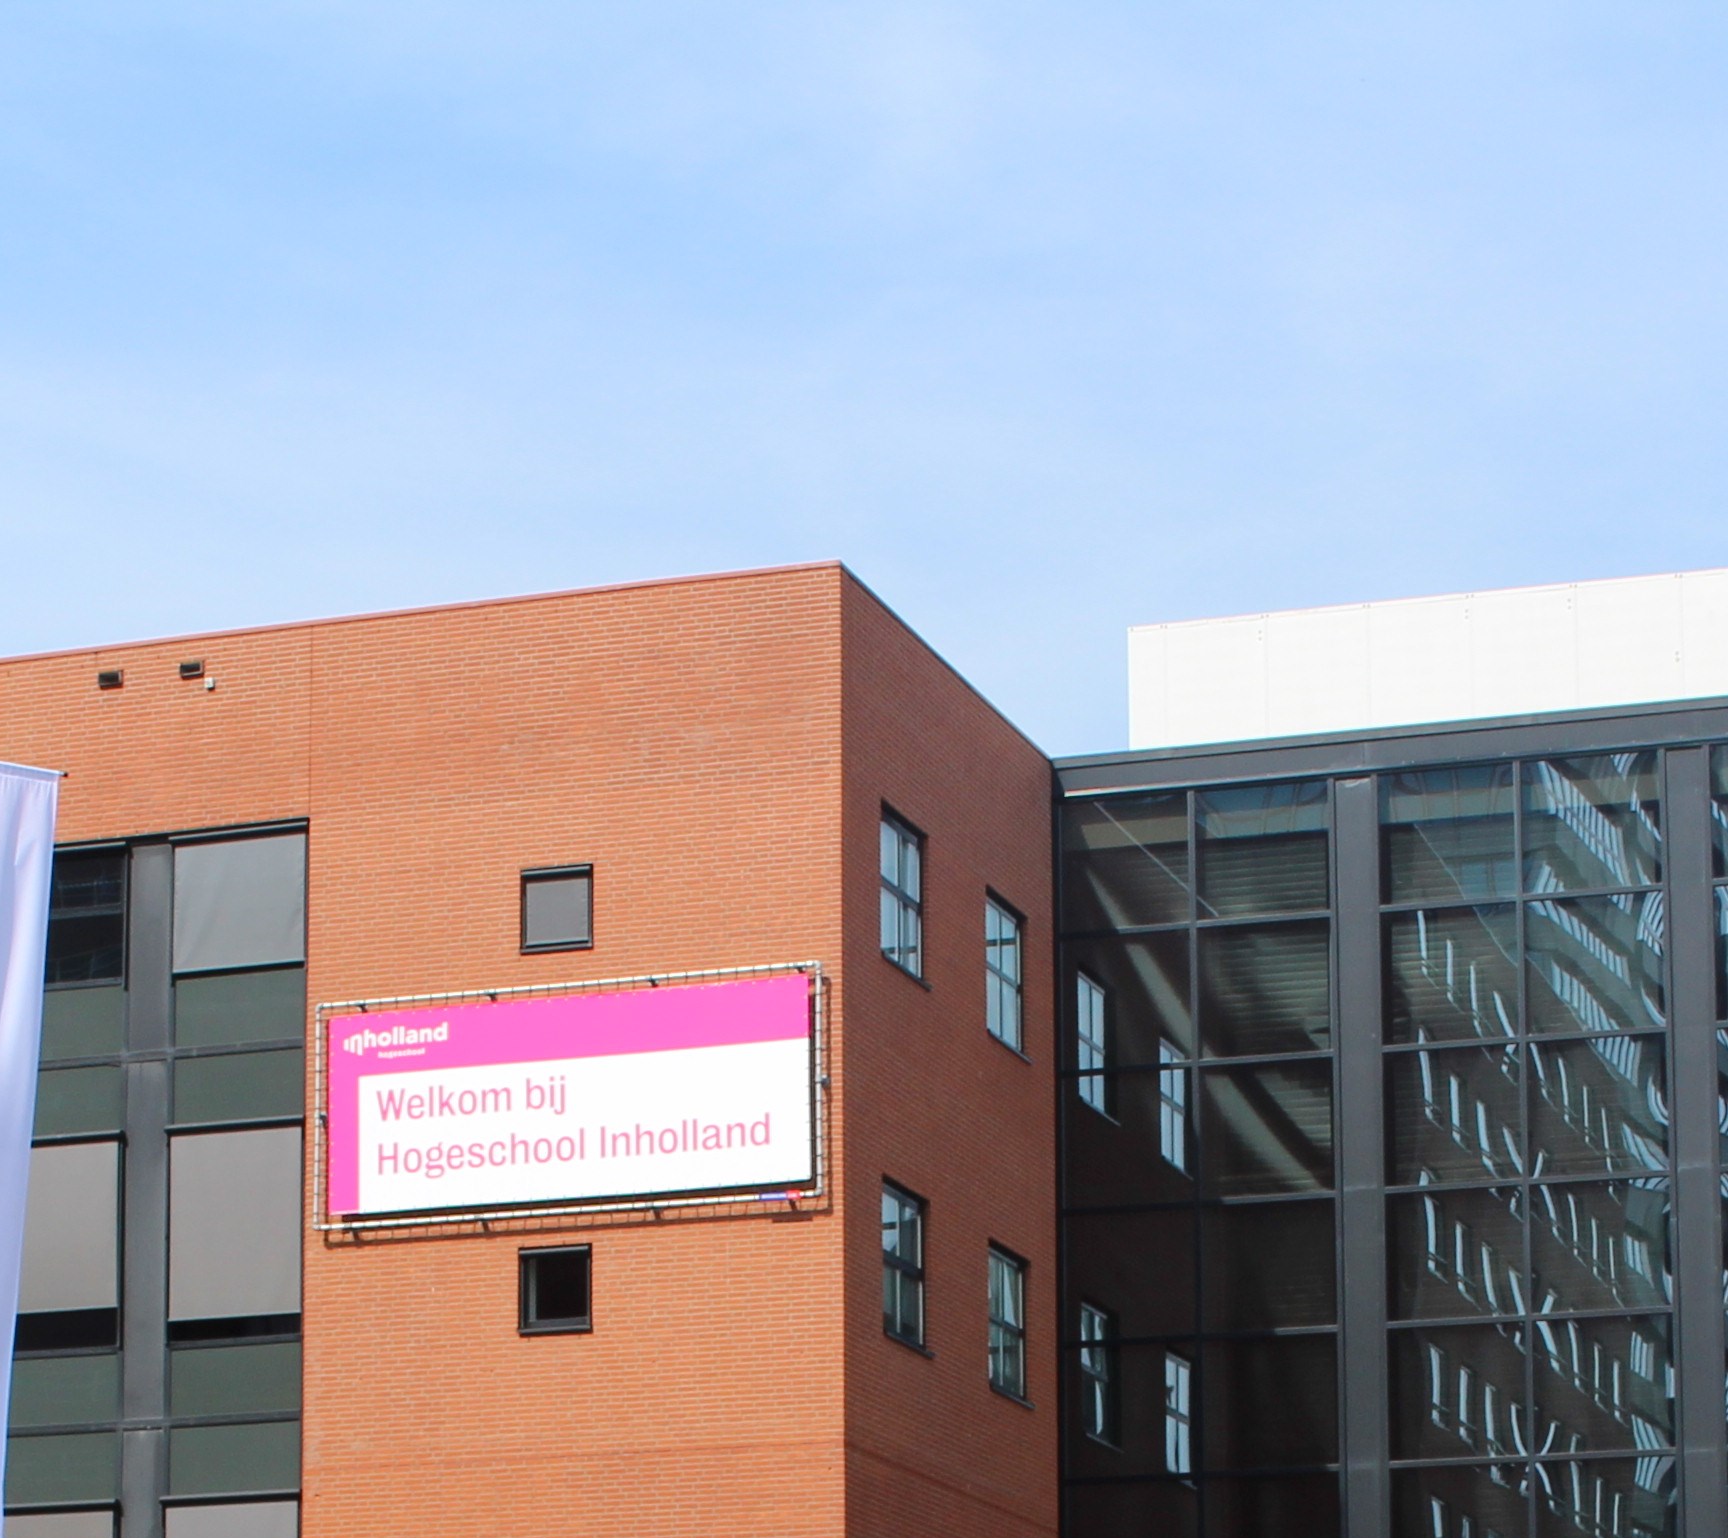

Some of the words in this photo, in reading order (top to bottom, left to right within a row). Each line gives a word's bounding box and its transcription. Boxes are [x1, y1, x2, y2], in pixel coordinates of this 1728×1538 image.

[343, 1021, 449, 1056] inholland
[377, 1047, 426, 1059] hogeschool
[377, 1084, 512, 1121] Welkom
[525, 1075, 566, 1116] bij
[378, 1127, 585, 1179] Hogeschool
[600, 1112, 771, 1159] Inholland
